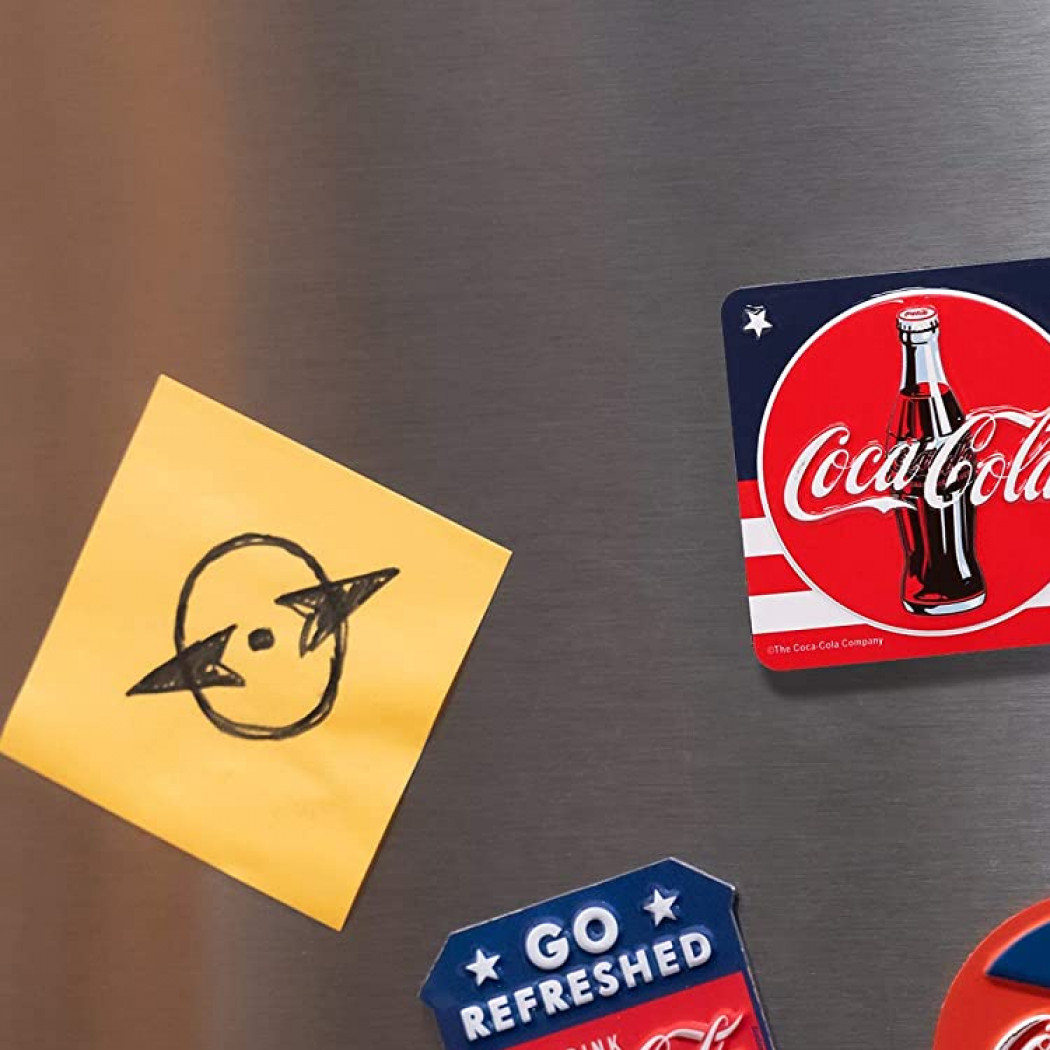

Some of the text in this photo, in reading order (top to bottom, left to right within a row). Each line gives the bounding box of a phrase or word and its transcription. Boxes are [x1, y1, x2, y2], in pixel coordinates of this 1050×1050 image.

[841, 637, 884, 648] Company
[525, 906, 619, 970] GO
[460, 932, 713, 1042] REFRESHED
